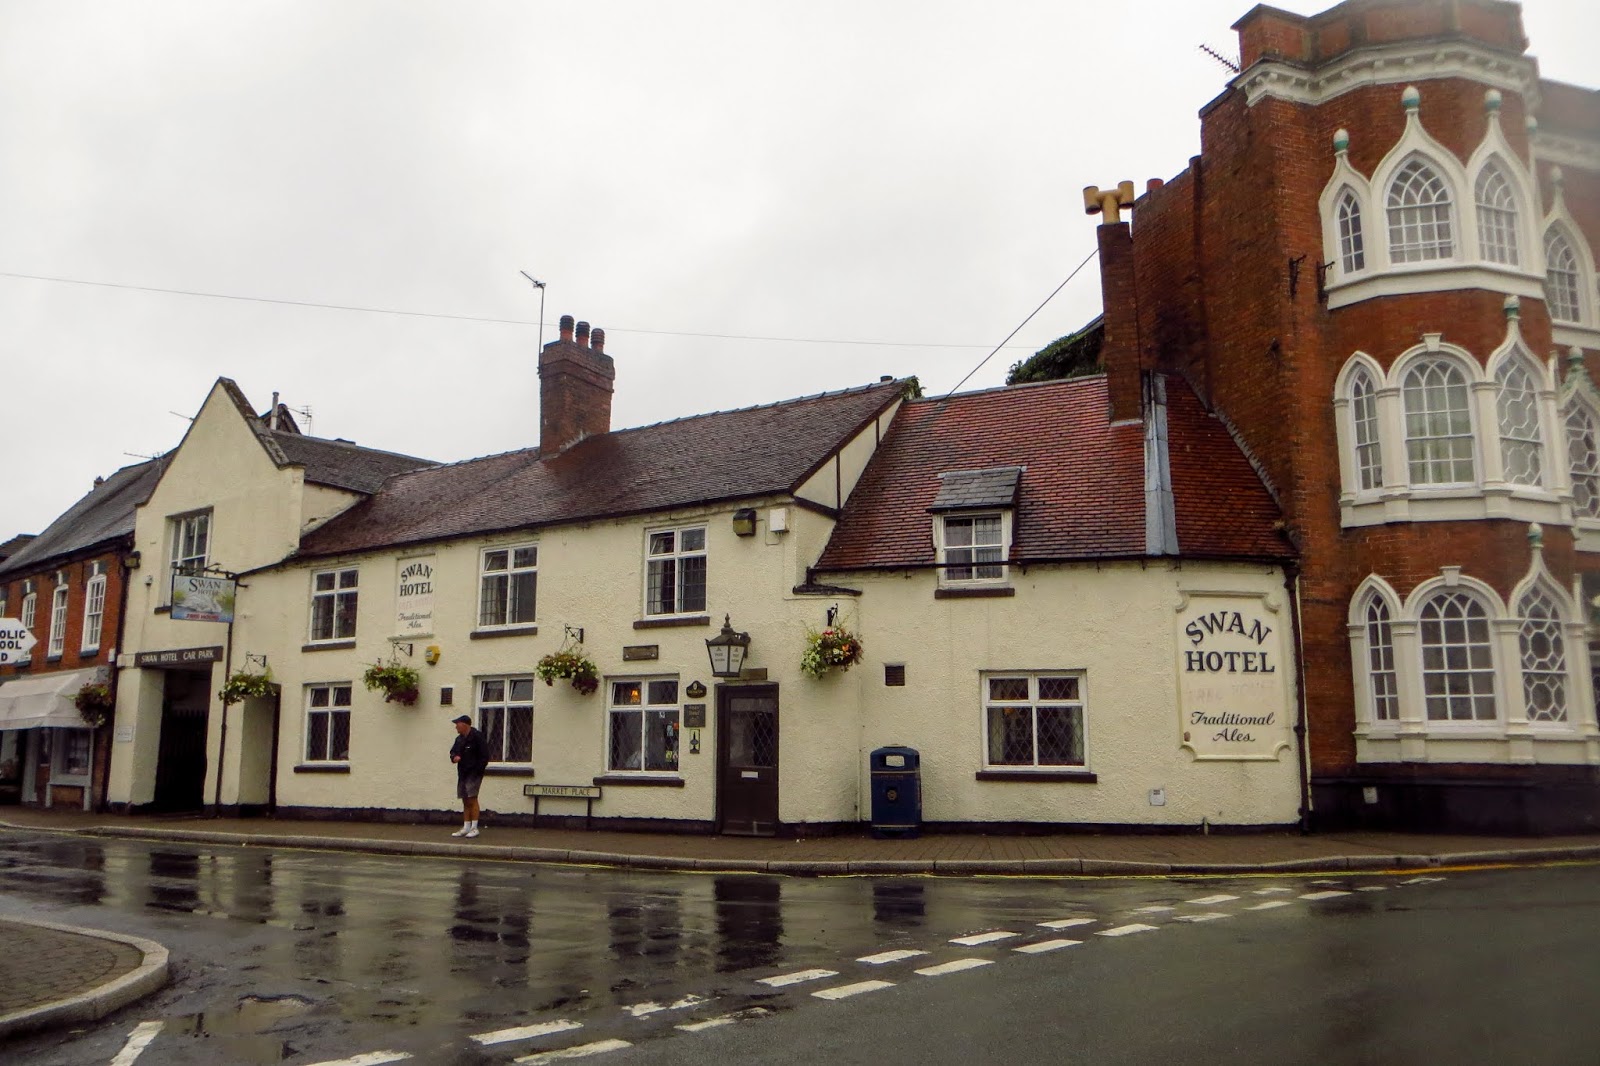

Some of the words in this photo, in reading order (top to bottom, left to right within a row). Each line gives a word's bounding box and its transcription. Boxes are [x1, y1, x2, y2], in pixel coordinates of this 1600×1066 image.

[401, 563, 433, 582] SWAN
[189, 578, 221, 592] SWAN
[400, 582, 433, 597] HOTEL
[1185, 611, 1272, 646] SWAN
[141, 654, 158, 663] SWAN
[160, 653, 178, 662] HOTEL
[183, 651, 196, 660] CAR
[199, 649, 214, 659] PARK
[1185, 651, 1275, 673] HOTEL
[1190, 711, 1276, 726] Traditional
[1212, 727, 1256, 742] Ales
[541, 787, 568, 795] MARKET
[571, 788, 590, 796] PLACE
